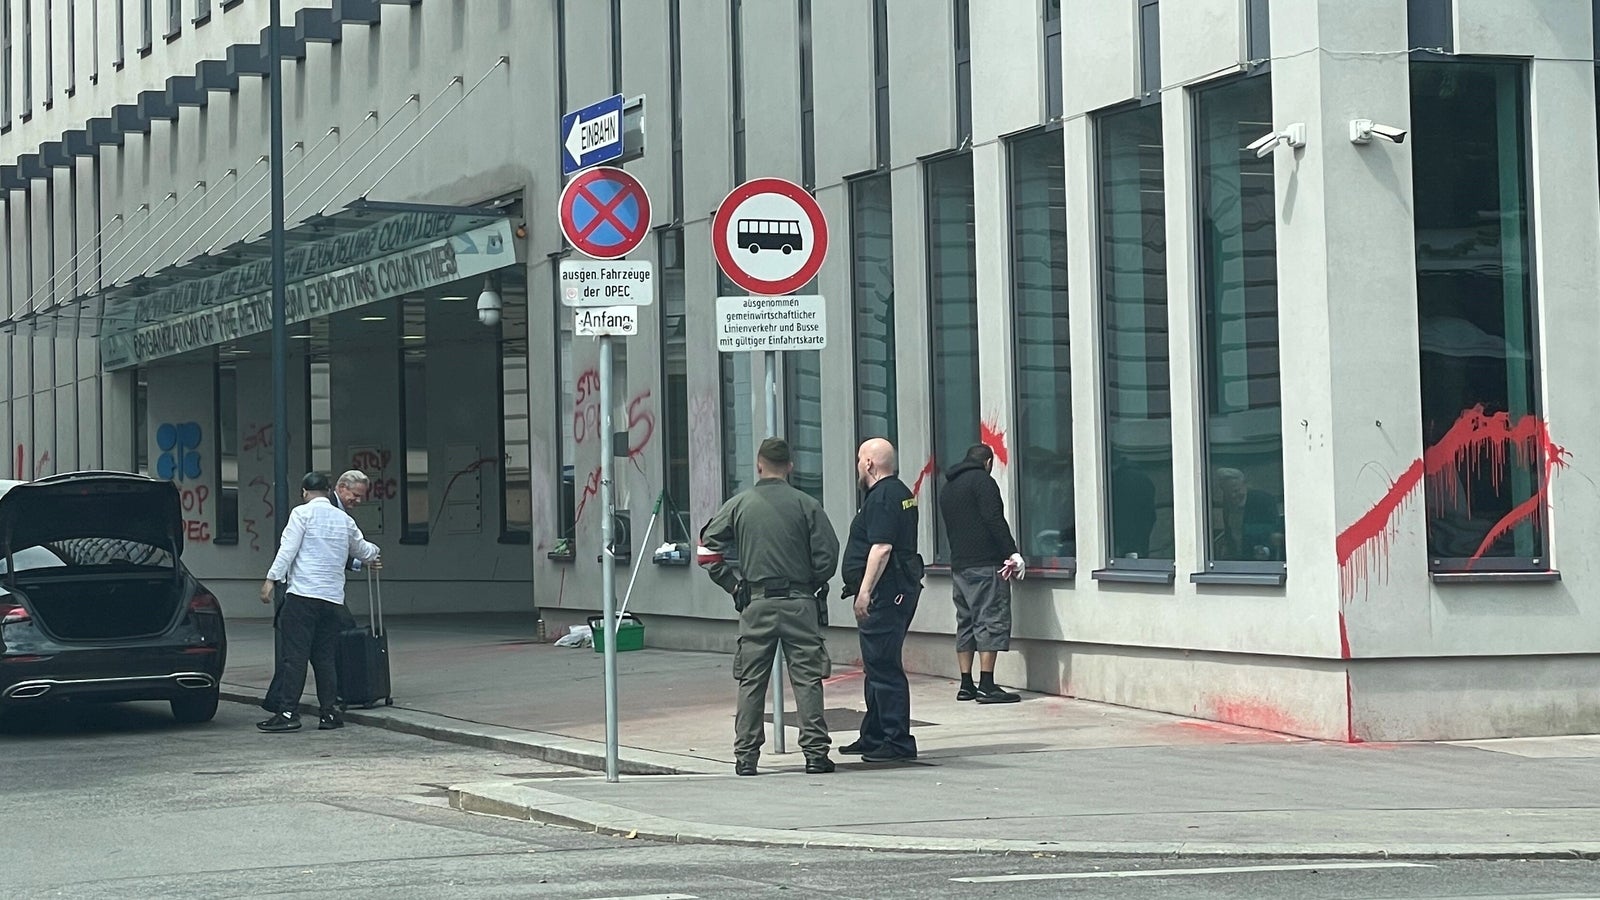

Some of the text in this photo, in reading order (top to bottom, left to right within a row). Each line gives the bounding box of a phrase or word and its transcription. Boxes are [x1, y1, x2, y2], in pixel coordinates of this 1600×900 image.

[581, 115, 616, 150] EINBAHN
[562, 268, 651, 282] ausgen. Fahrzeuge
[583, 285, 630, 297] der OPEC
[134, 317, 199, 359] ORGANIZATION
[200, 313, 214, 342] OF
[214, 307, 236, 338] THE
[306, 265, 378, 314] EXPORTING
[378, 243, 458, 294] COUNTRIES
[743, 299, 799, 309] ausgenommen
[726, 310, 816, 322] gemeinwirtschaftlicher
[724, 322, 819, 333] Linienverkehr und Busse
[720, 335, 824, 347] mit gültiger Einfahrtskarte
[576, 367, 601, 405] STO
